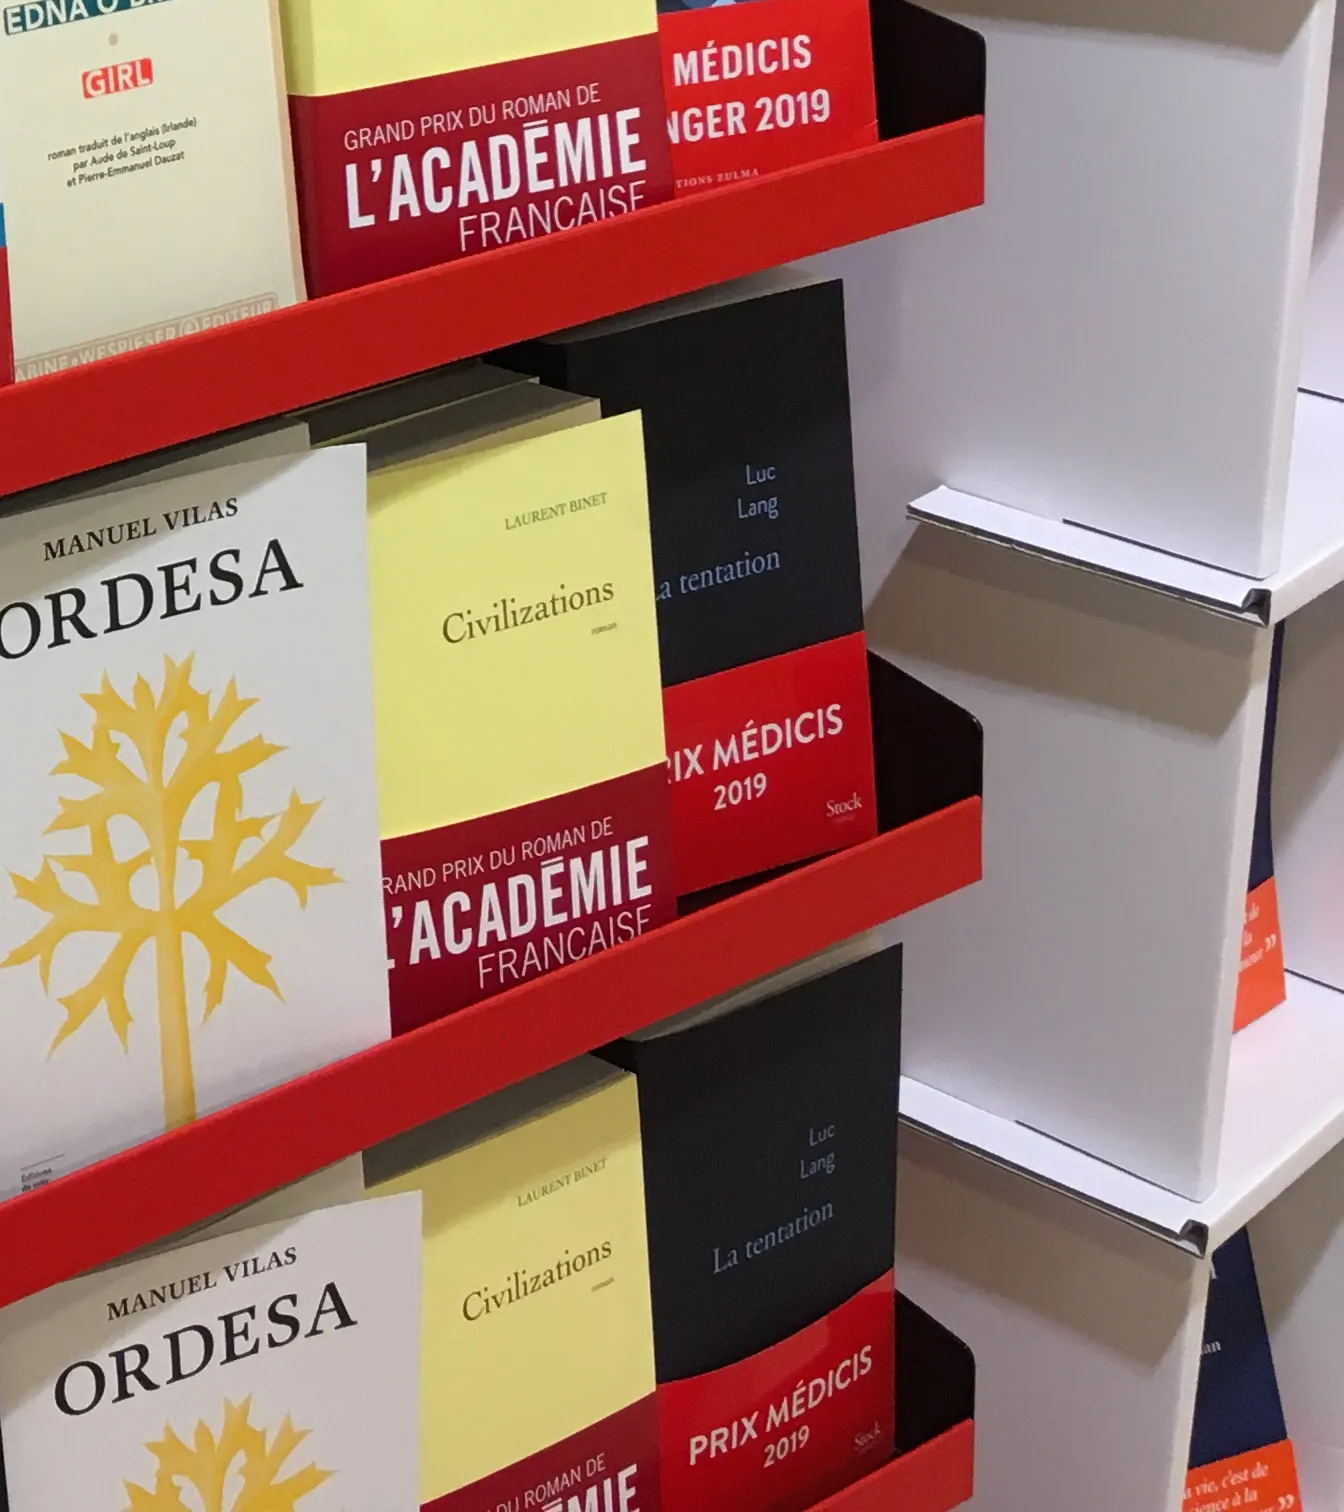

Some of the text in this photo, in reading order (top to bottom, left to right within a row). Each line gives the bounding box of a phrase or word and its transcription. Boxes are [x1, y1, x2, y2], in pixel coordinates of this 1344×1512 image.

[85, 58, 152, 98] GIRL
[672, 33, 812, 87] MÉDICIS
[754, 88, 831, 133] 2019
[47, 117, 197, 161] roman traduit de l'anglais (Irlande)
[73, 139, 176, 172] par Aude de Saint-Loup
[67, 151, 185, 187] et Pierre-Emmanuel Dauzat
[716, 166, 759, 183] ZULMA
[745, 463, 777, 486] Luc
[43, 497, 239, 562] MANUEL VILAS
[504, 491, 608, 531] LAURENT BINET
[737, 494, 779, 521] Lang
[679, 548, 781, 596] tentation
[442, 577, 615, 645] Civilizations
[712, 703, 844, 772] MÉDICIS
[713, 773, 768, 811] 2019
[826, 793, 862, 818] Stock
[516, 1156, 608, 1208] LAURENT BINET
[711, 1200, 835, 1276] La tentation
[107, 1246, 298, 1321] MANUEL VILAS
[461, 1239, 613, 1322] Civilizations
[688, 1344, 873, 1466] PRIX MÉDICIS
[763, 1424, 811, 1469] 2019
